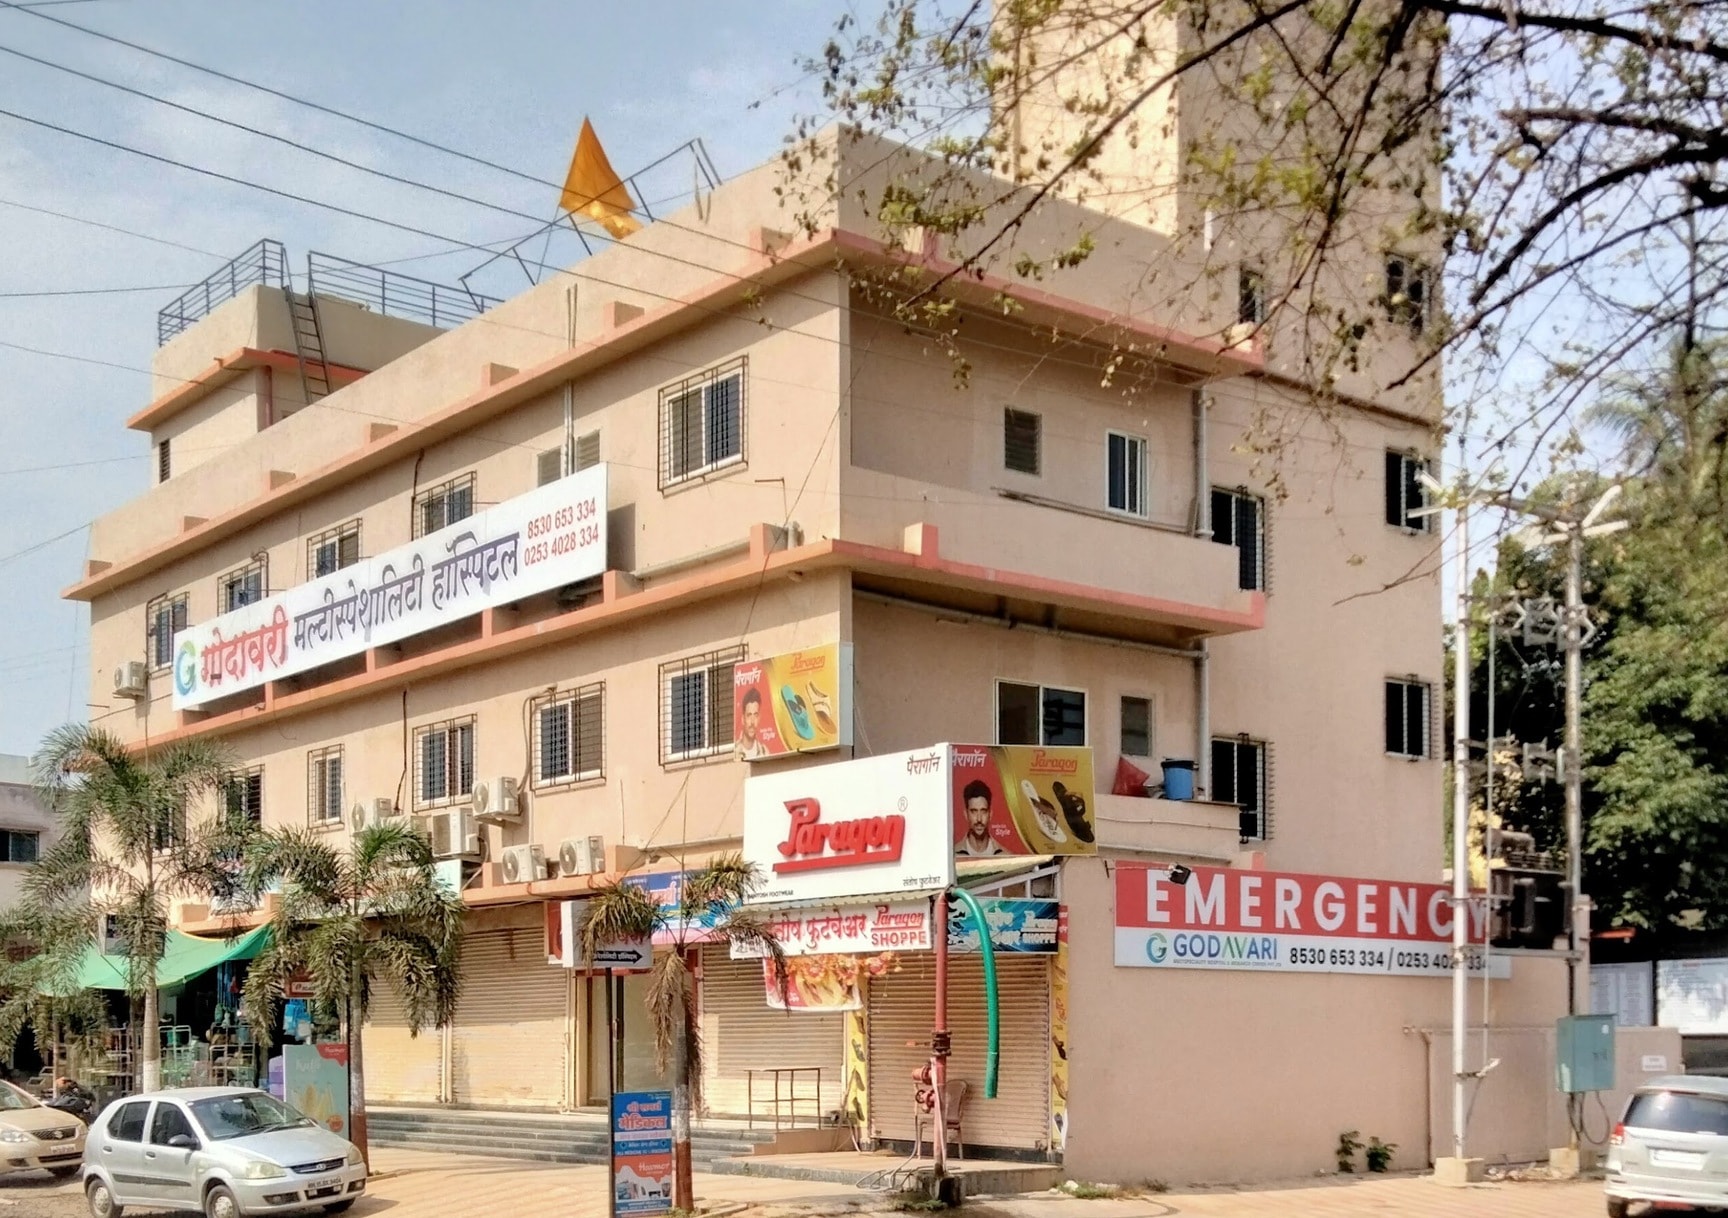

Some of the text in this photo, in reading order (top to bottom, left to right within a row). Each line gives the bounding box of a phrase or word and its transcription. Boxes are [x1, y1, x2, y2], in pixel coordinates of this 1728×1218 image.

[528, 497, 596, 540] 8530 653 334
[524, 523, 599, 566] 0253 4028 334
[200, 604, 289, 688] गोदावरी
[432, 531, 520, 611] हॉस्पिटल
[1031, 750, 1078, 771] Paragon
[776, 797, 906, 862] Paragon
[872, 904, 925, 931] Paragon
[1147, 869, 1486, 940] EMERGENCY
[872, 931, 927, 946] SHOPPE
[1173, 933, 1278, 960] GODAVARI
[1290, 947, 1326, 965] 8530
[1330, 949, 1355, 966] 653
[1359, 951, 1385, 967] 334
[1397, 951, 1429, 969] 0253
